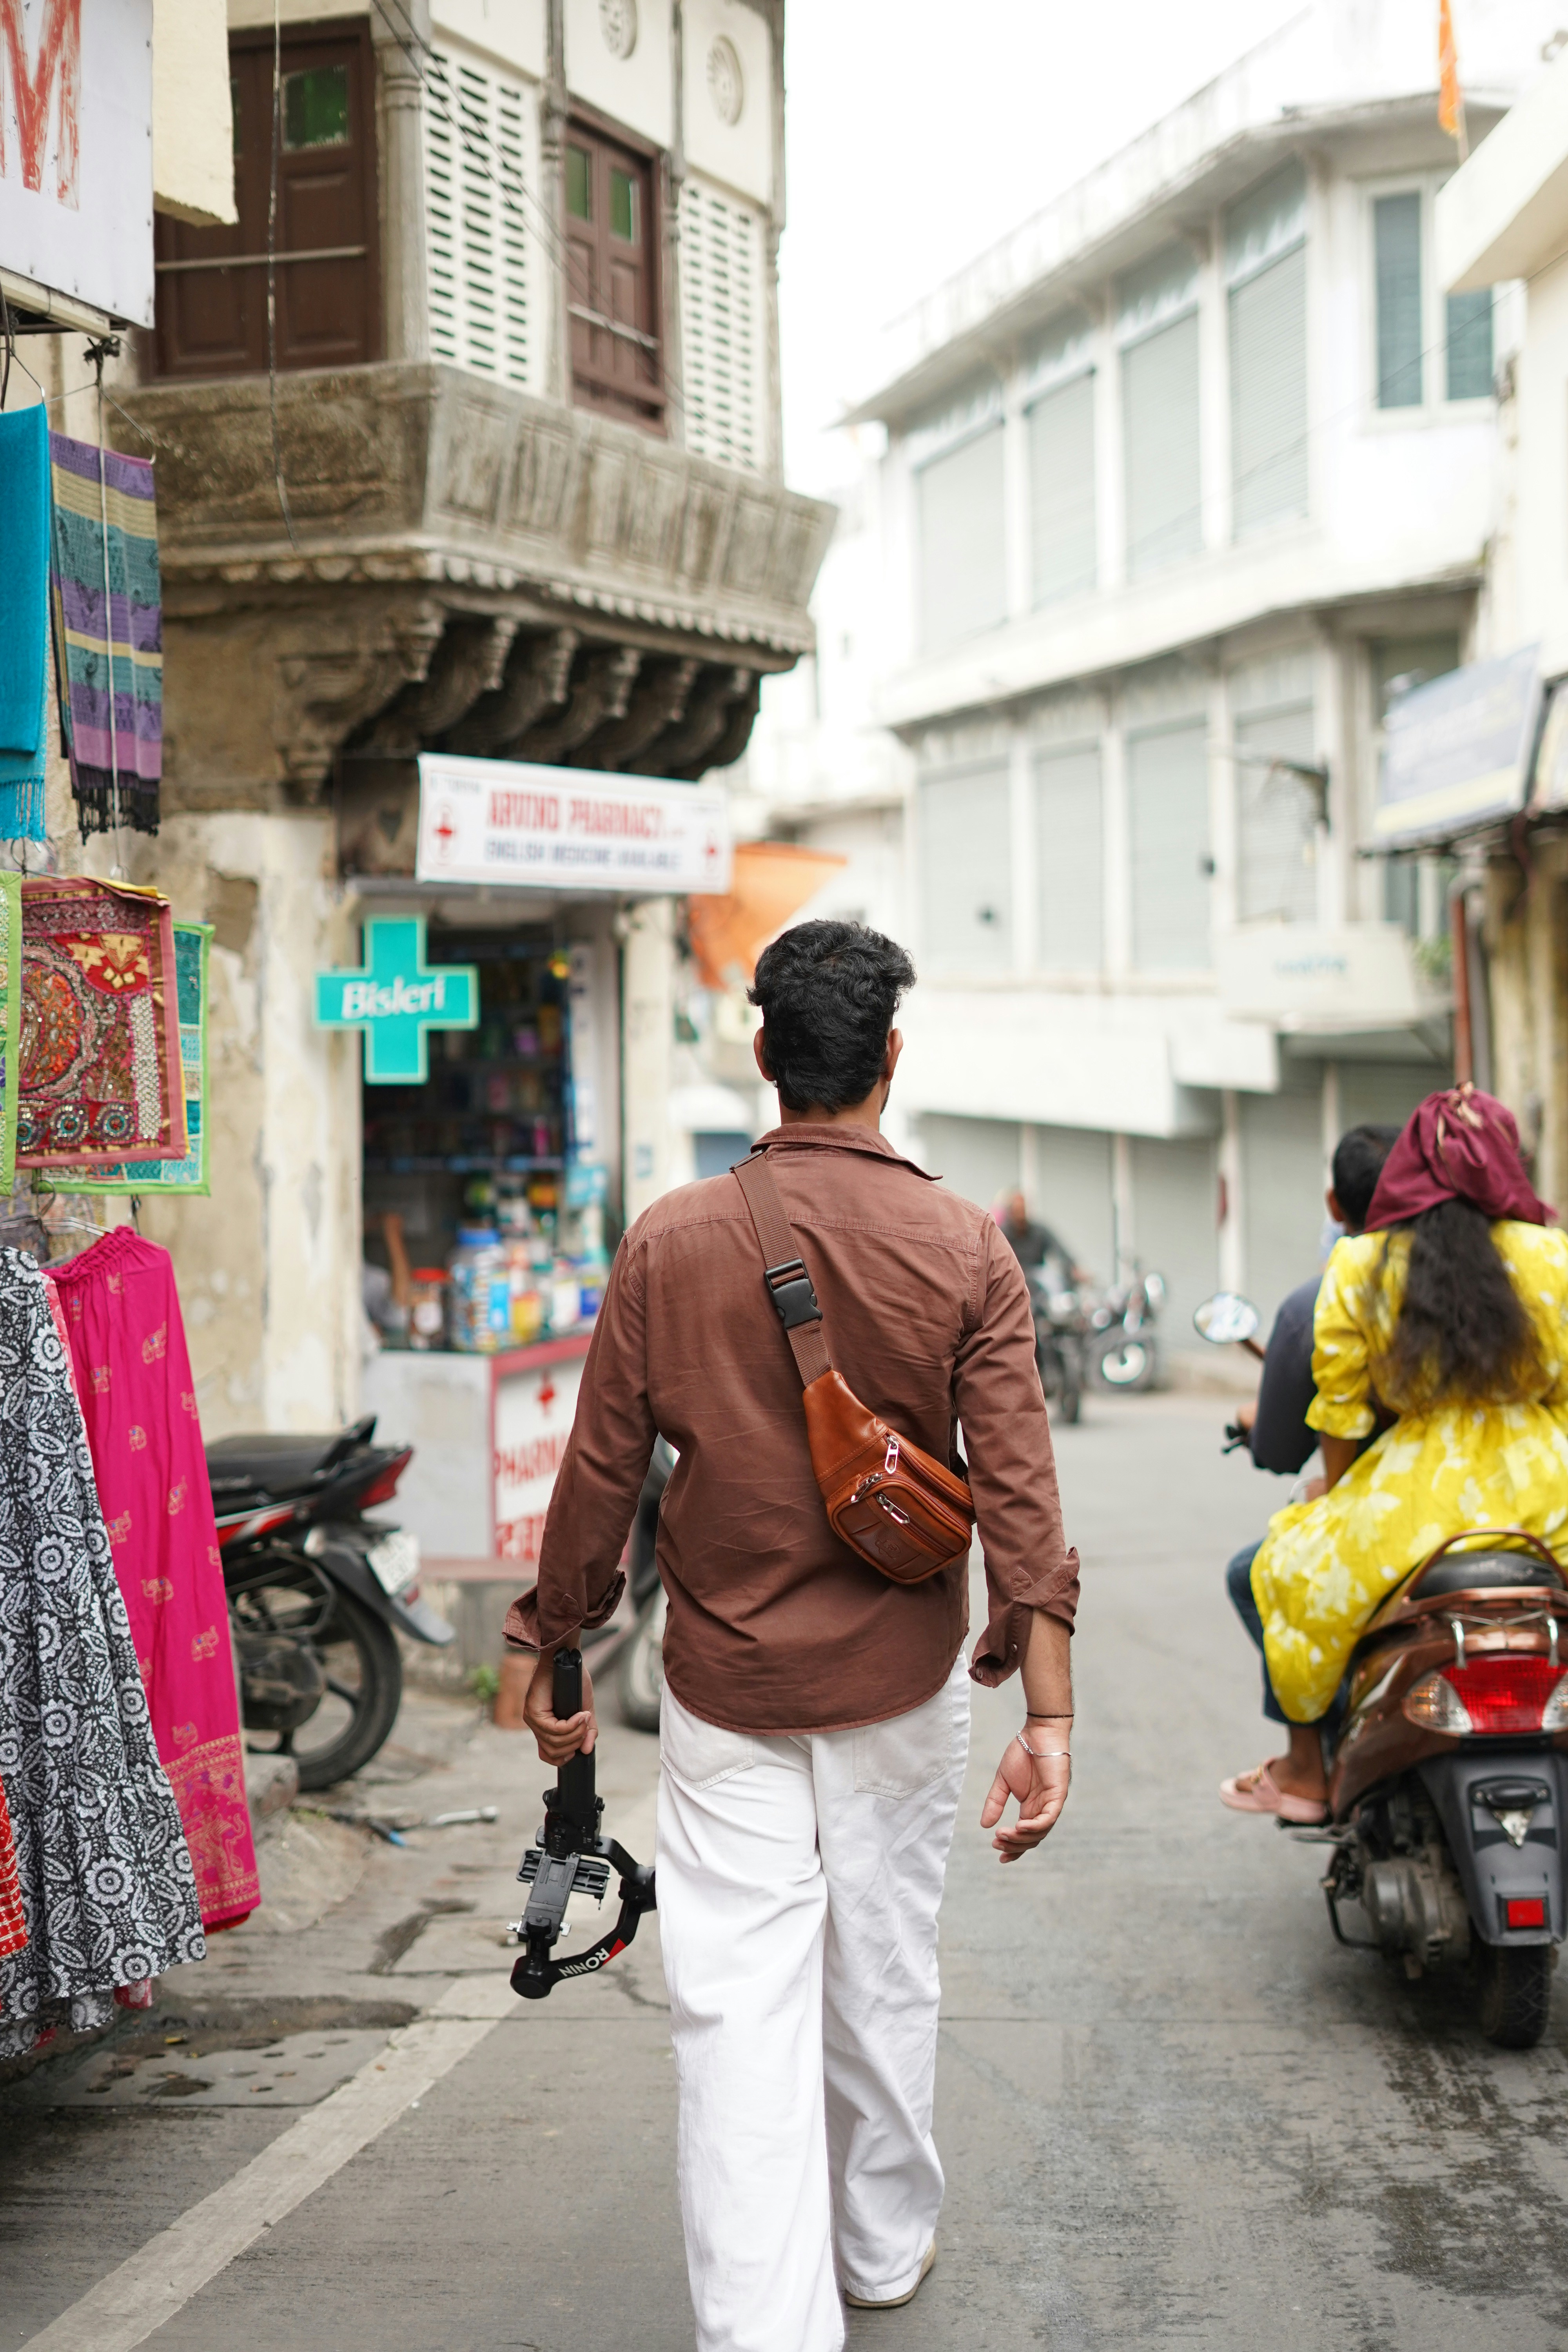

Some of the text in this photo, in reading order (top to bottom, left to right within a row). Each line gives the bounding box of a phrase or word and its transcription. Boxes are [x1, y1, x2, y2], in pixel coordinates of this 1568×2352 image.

[488, 790, 663, 839] ARVIND PHARMACY
[486, 839, 544, 861] ENGLISH
[341, 974, 445, 1019] Bisleri
[558, 1947, 610, 1976] RONIN
